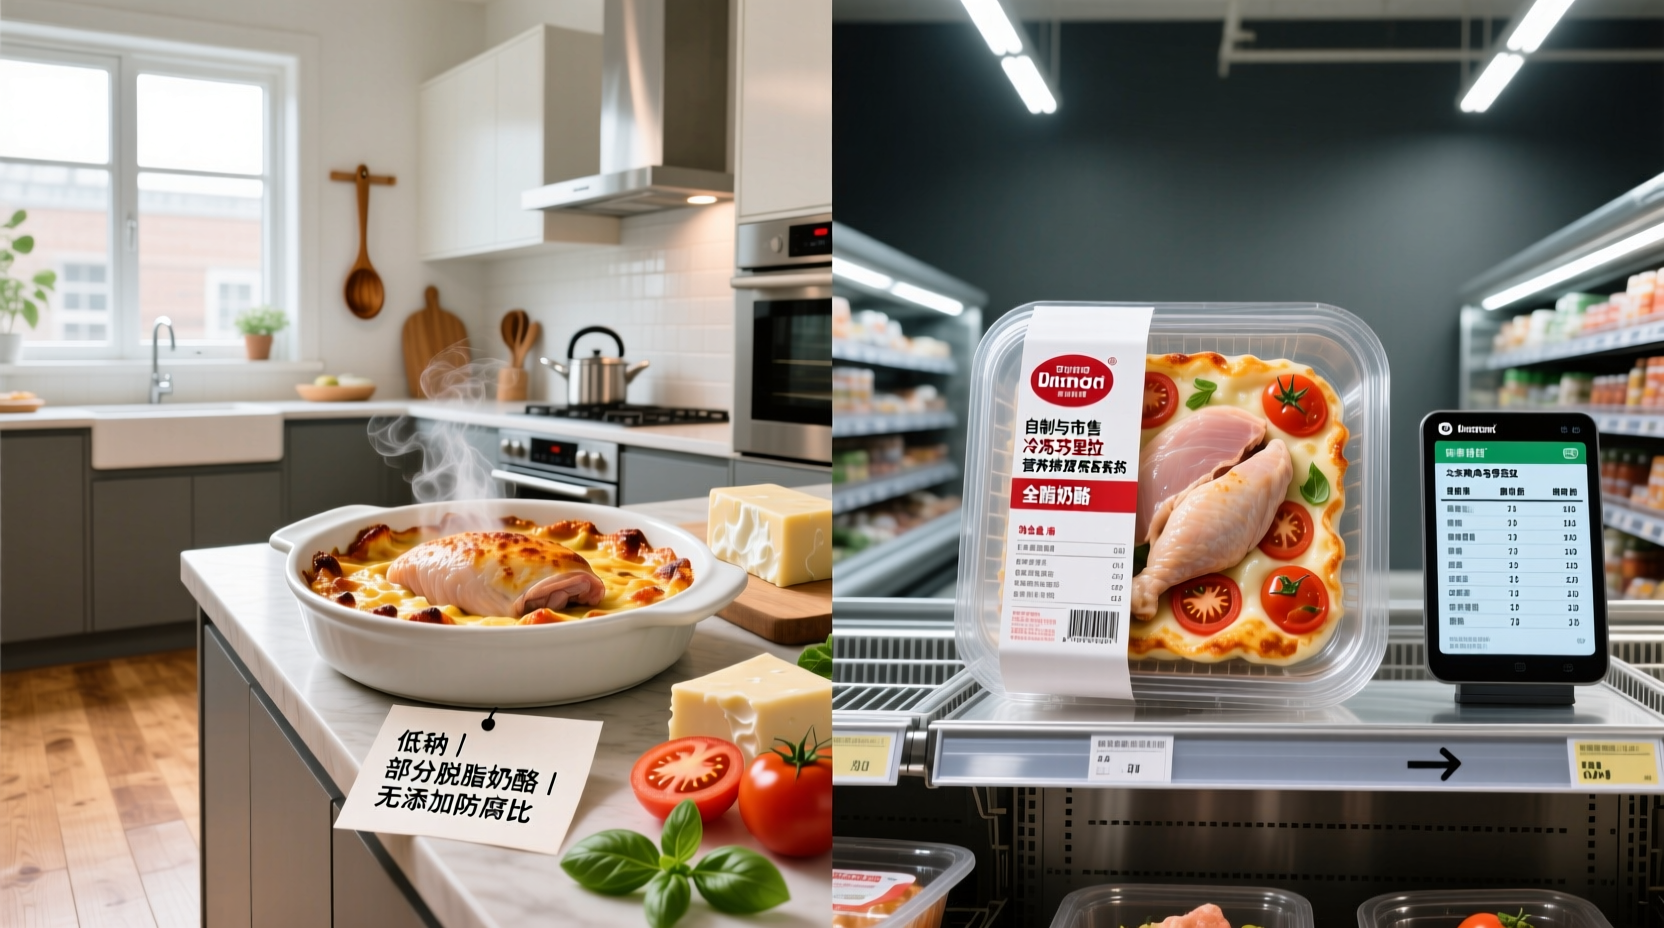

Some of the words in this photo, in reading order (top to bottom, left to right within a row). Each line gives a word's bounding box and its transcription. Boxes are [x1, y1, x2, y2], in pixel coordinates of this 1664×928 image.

[1025, 417, 1102, 437] 自制与市售
[1022, 484, 1091, 506] 全脂奶酪
[385, 756, 540, 795] 部分脱脂奶酪
[374, 785, 533, 823] 无添加防腐比
